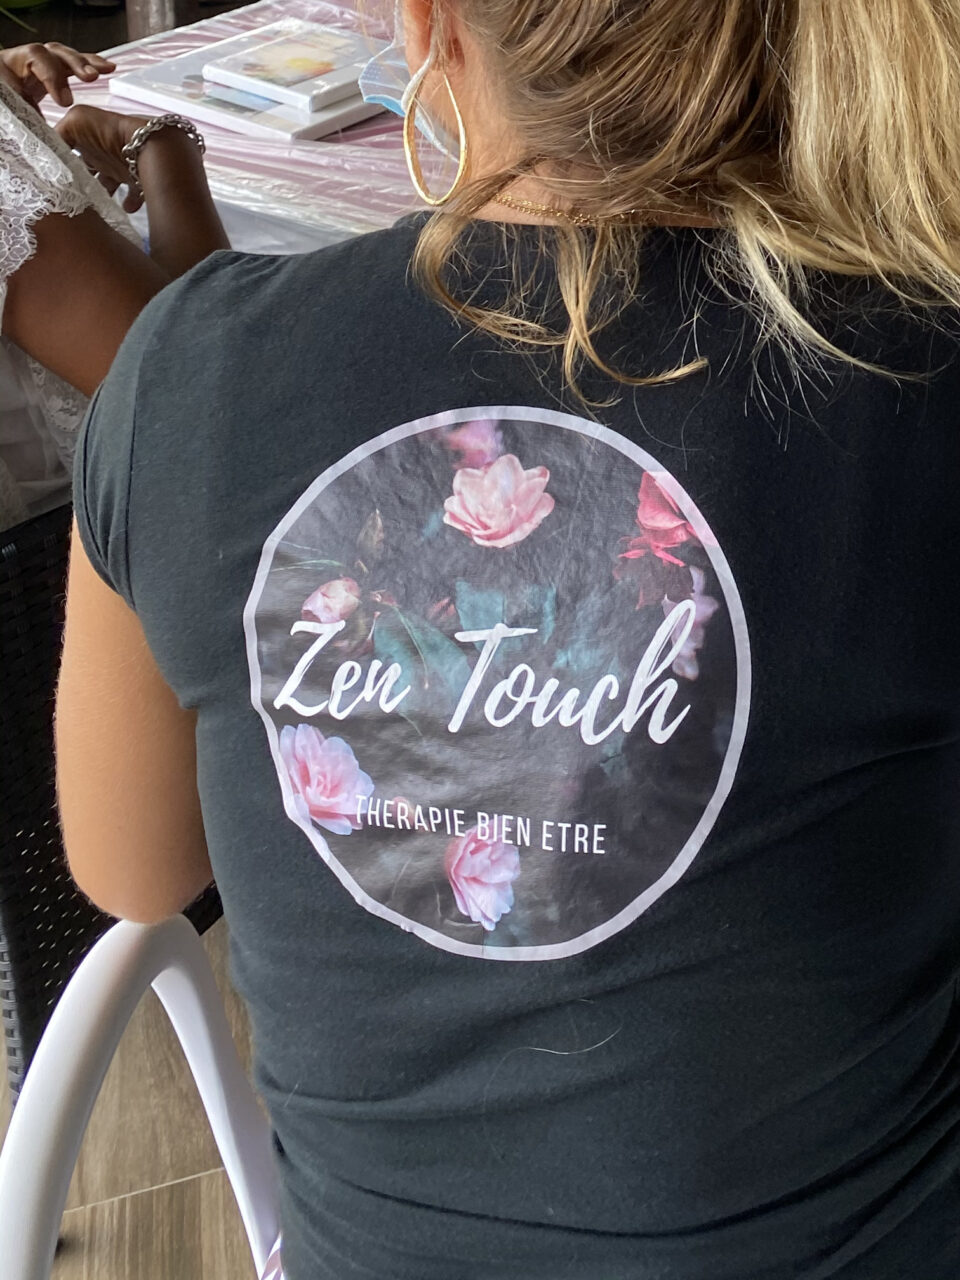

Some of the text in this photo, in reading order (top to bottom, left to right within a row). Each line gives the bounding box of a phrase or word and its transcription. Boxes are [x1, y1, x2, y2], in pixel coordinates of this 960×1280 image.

[273, 599, 696, 745] Zen Touch
[355, 794, 606, 855] THERAPIE BIEN ETRE
